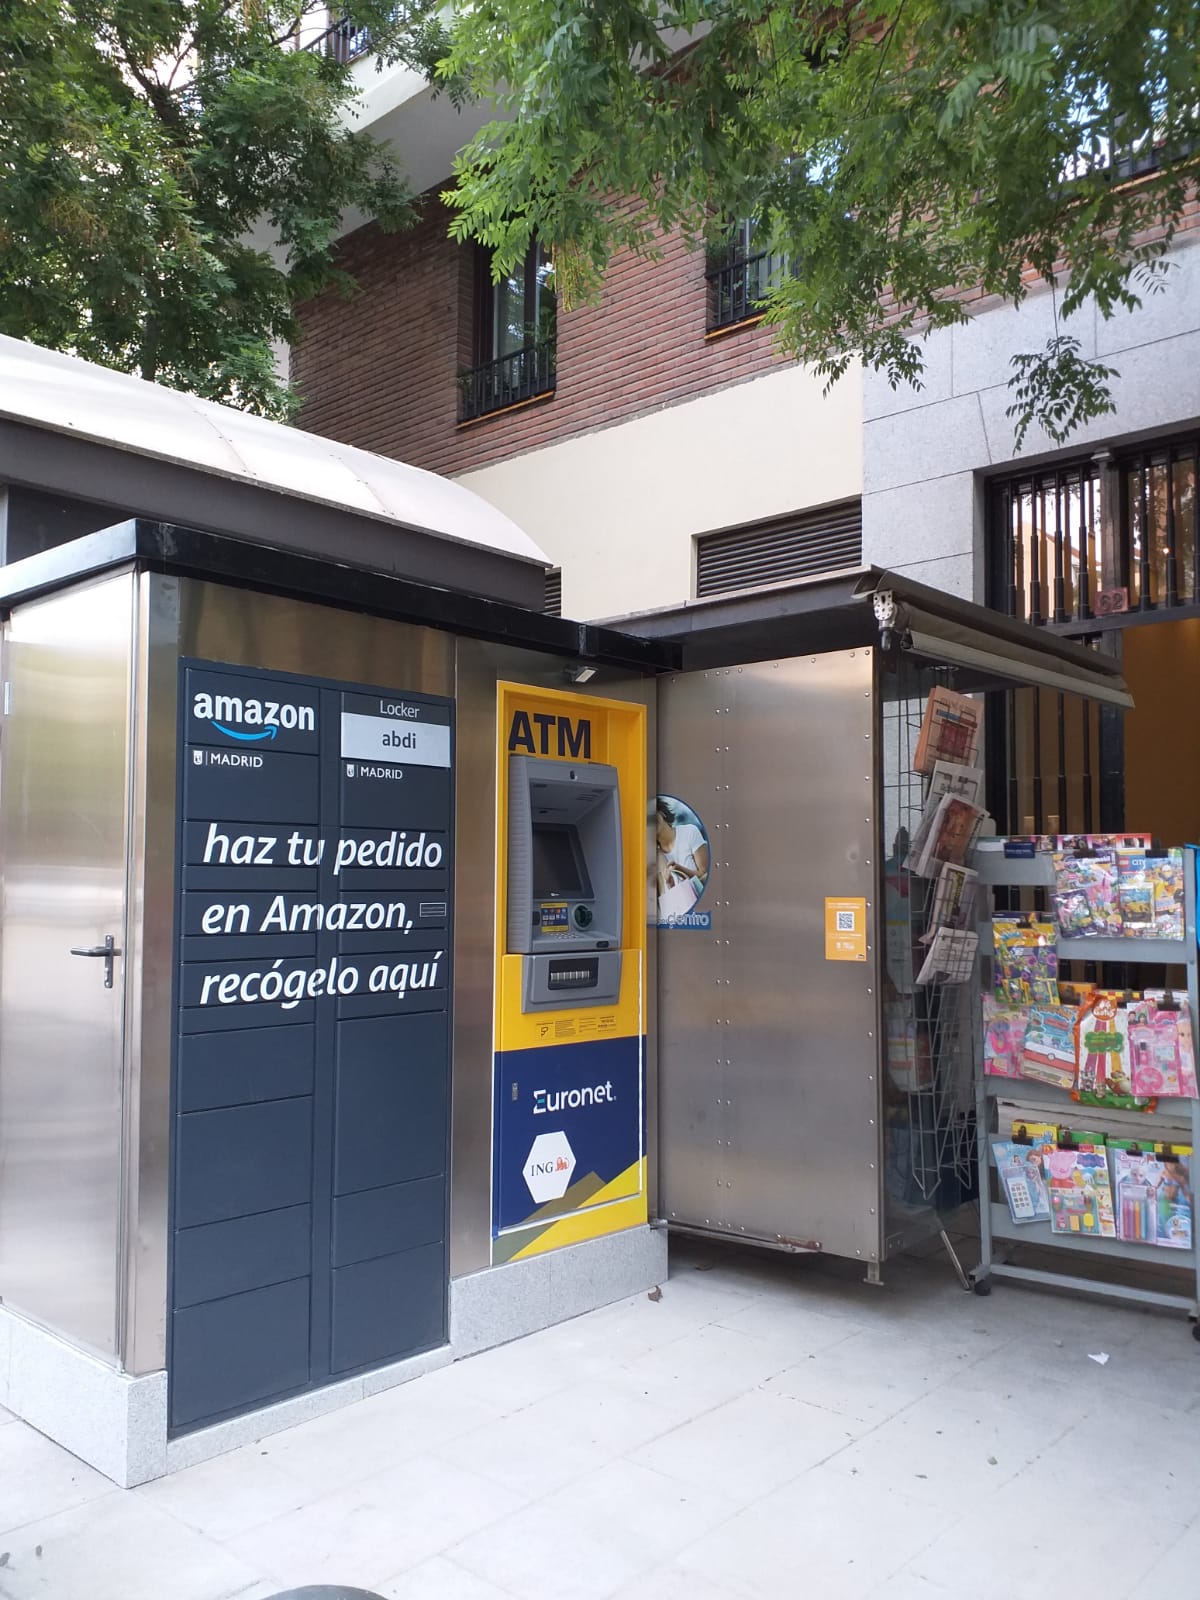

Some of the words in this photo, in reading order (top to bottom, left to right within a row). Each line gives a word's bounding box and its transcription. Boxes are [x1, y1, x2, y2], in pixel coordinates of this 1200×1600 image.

[1101, 592, 1122, 611] 62
[193, 692, 315, 731] amazon
[380, 700, 420, 718] Locker
[382, 730, 417, 749] abdi
[508, 710, 591, 759] ATM
[210, 752, 263, 768] MADRID
[360, 766, 403, 779] MADRID
[203, 823, 277, 864] haz
[287, 832, 325, 865] tu
[333, 831, 442, 875] pedido
[202, 904, 250, 934] en
[259, 895, 413, 934] Amazon,
[200, 957, 359, 1009] recógelo
[368, 951, 443, 999] aquí
[533, 1080, 613, 1114] Euronet
[531, 1162, 554, 1176] ING
